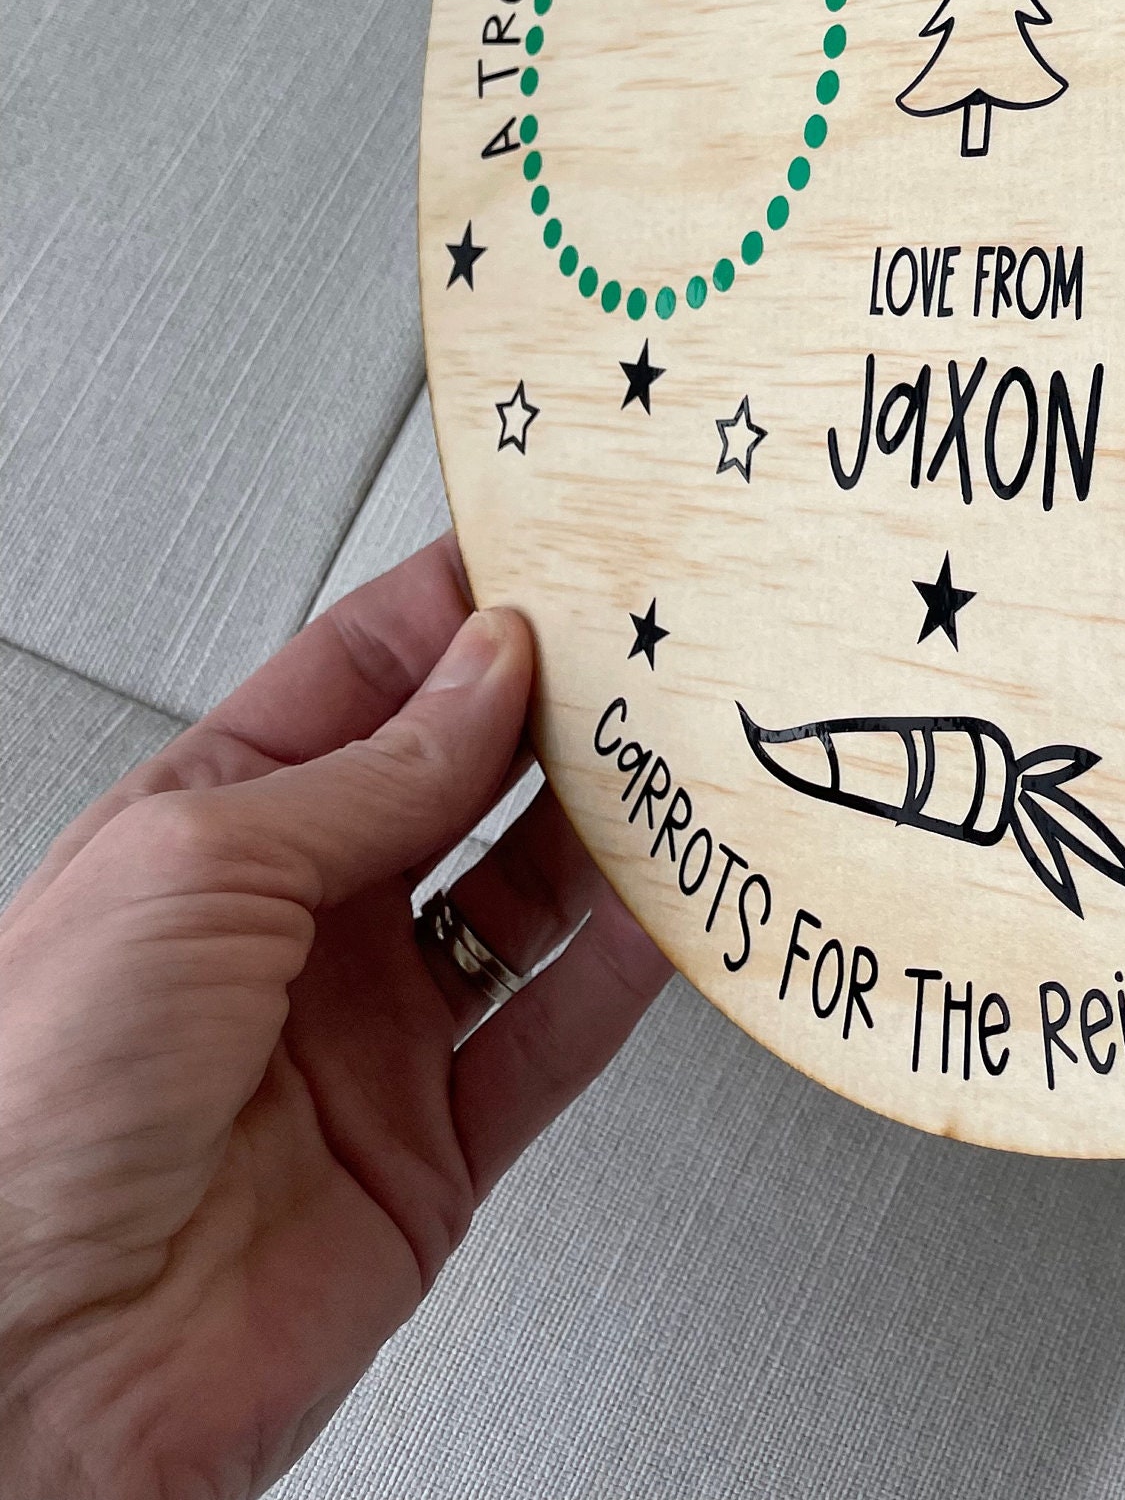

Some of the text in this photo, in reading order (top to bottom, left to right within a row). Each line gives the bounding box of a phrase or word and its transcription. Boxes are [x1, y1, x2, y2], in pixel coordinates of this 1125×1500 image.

[480, 116, 521, 160] A
[869, 245, 1084, 321] LOVE FROM
[779, 908, 880, 1040] FOR
